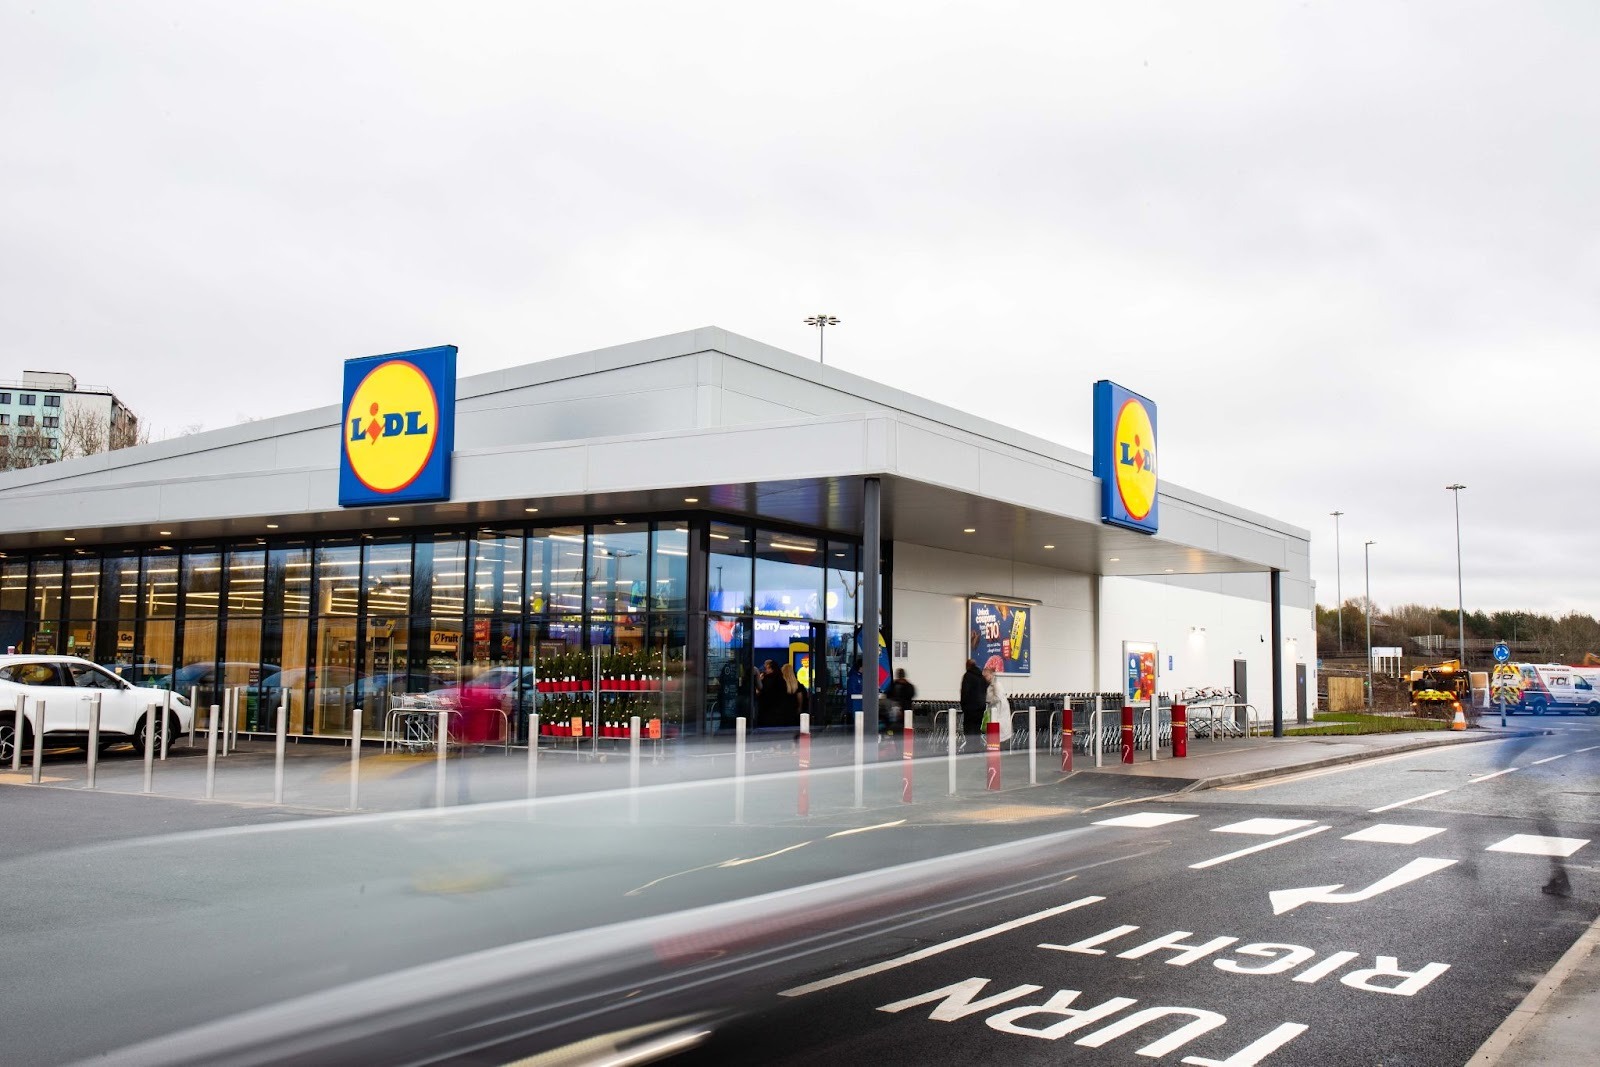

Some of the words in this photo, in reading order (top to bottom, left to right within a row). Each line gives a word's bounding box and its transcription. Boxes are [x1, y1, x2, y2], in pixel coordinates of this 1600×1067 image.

[121, 633, 132, 641] Go
[440, 633, 458, 643] Fruit
[986, 622, 998, 639] £10
[1037, 925, 1452, 996] RIGHT
[876, 976, 1310, 1067] TURN
